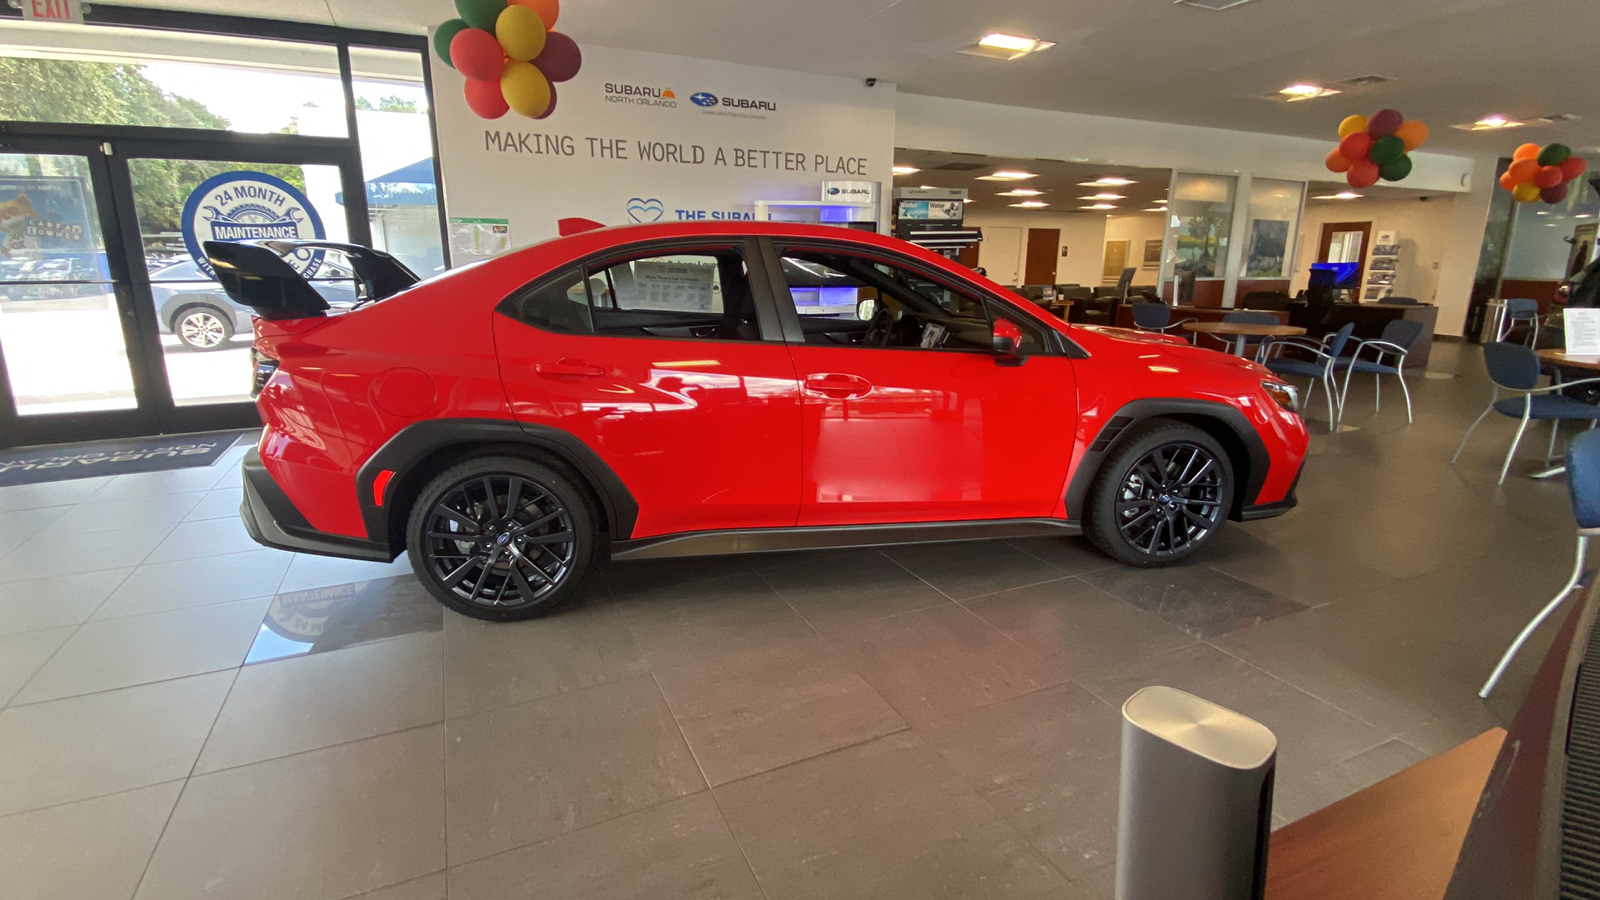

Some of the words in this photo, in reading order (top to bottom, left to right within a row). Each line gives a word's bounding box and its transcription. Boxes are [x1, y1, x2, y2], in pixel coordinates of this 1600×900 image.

[604, 83, 661, 98] SUBARU
[604, 95, 635, 105] NORTH
[636, 98, 677, 109] ORLANDO
[721, 97, 777, 111] SUBARU
[484, 130, 575, 157] MAKING
[585, 137, 628, 160] THE
[637, 140, 705, 165] WORLD
[714, 147, 727, 166] A
[733, 148, 807, 172] BETTER
[814, 154, 868, 175] PLACE
[214, 190, 234, 207] 24
[233, 185, 286, 207] MONTH
[711, 211, 771, 221] SUBA
[213, 225, 297, 240] MAINTENANCE
[303, 257, 322, 279] CHASE
